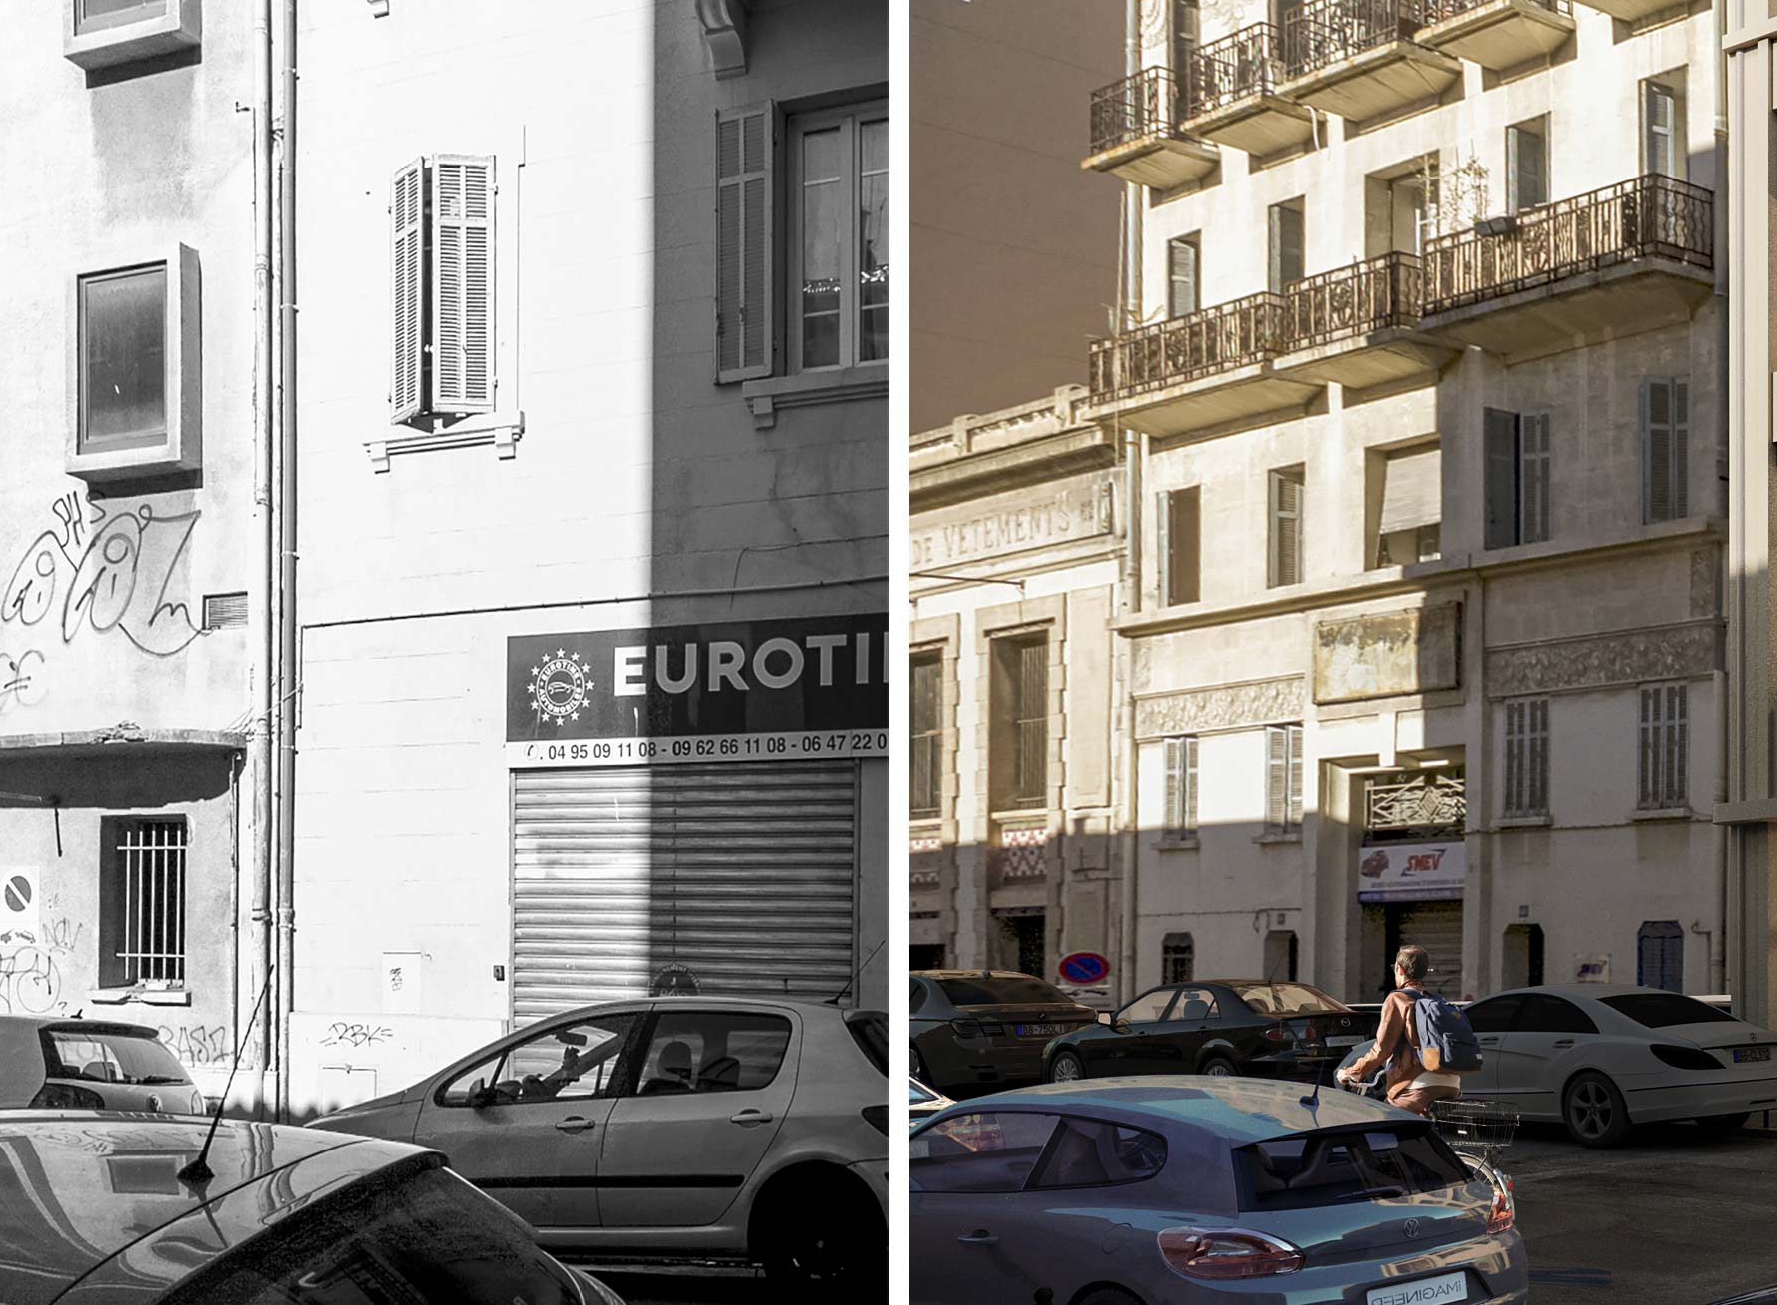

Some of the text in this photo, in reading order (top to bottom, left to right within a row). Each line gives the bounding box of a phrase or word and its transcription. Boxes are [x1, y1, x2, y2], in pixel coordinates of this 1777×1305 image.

[613, 632, 889, 697] EUROTI
[548, 745, 565, 759] 04
[572, 745, 588, 759] 95
[593, 743, 611, 758] 09
[619, 743, 632, 757] 11
[638, 742, 657, 757] 08
[672, 740, 691, 756] 09
[696, 740, 715, 755] 62
[720, 739, 739, 754] 66
[745, 738, 759, 753] 11
[767, 737, 786, 753] 08
[802, 736, 821, 752] 06
[826, 735, 846, 750] 47
[852, 734, 872, 750] 22
[1405, 853, 1441, 872] SMEV
